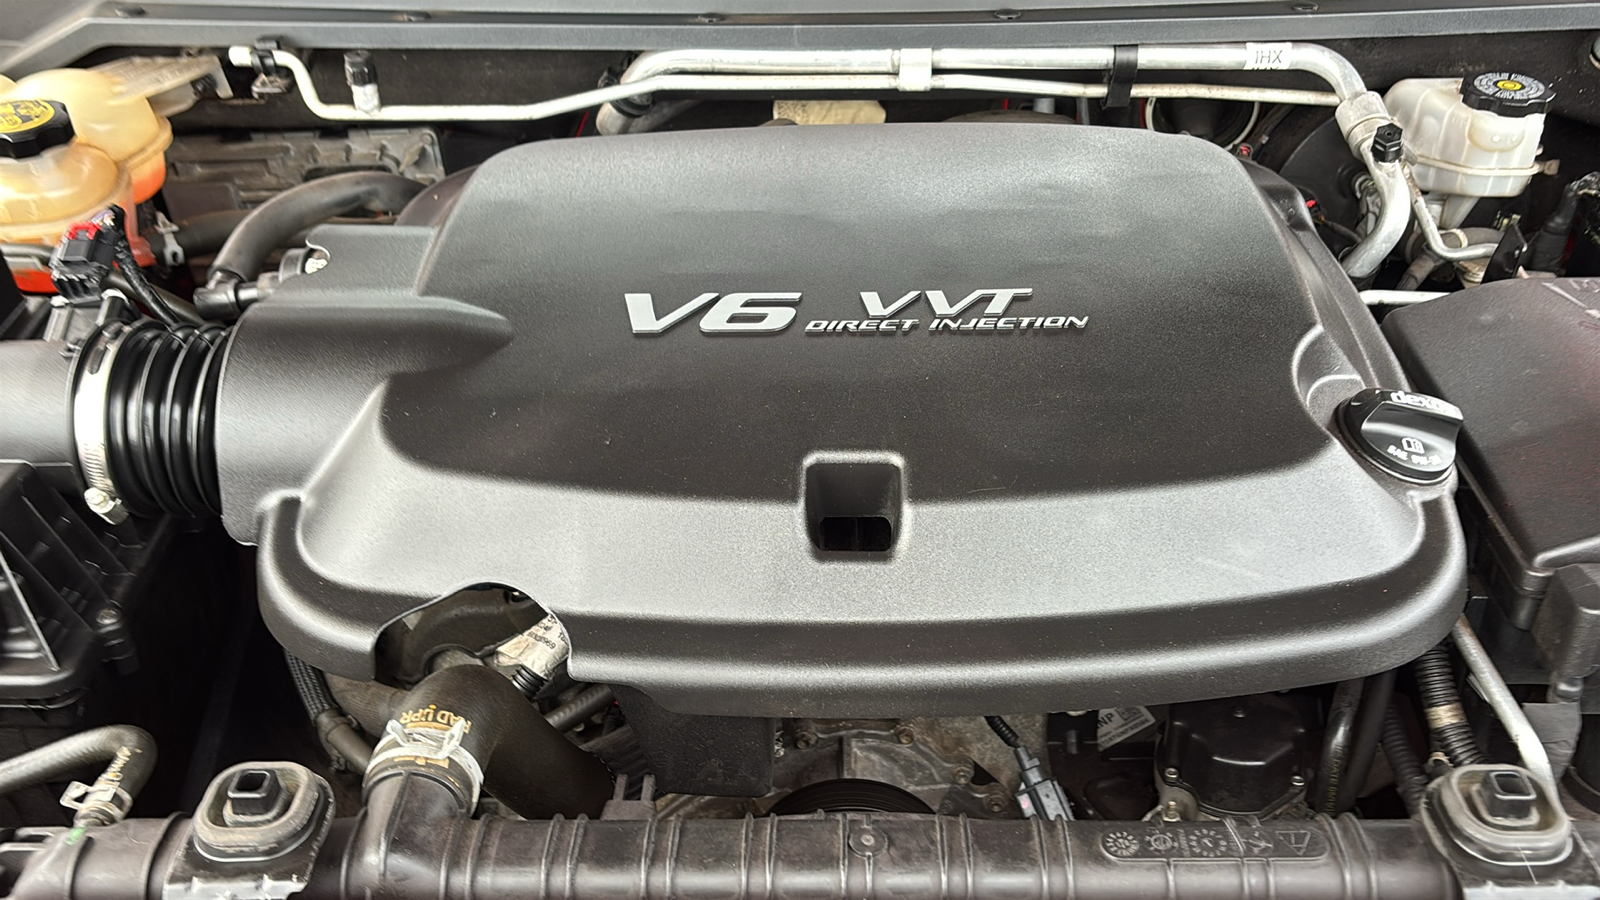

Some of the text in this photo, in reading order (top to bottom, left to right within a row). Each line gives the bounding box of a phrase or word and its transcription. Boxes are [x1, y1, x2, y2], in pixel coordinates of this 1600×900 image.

[624, 292, 803, 334] V6
[860, 287, 1033, 319] VVT
[804, 315, 1089, 332] DIRECT INJECTION
